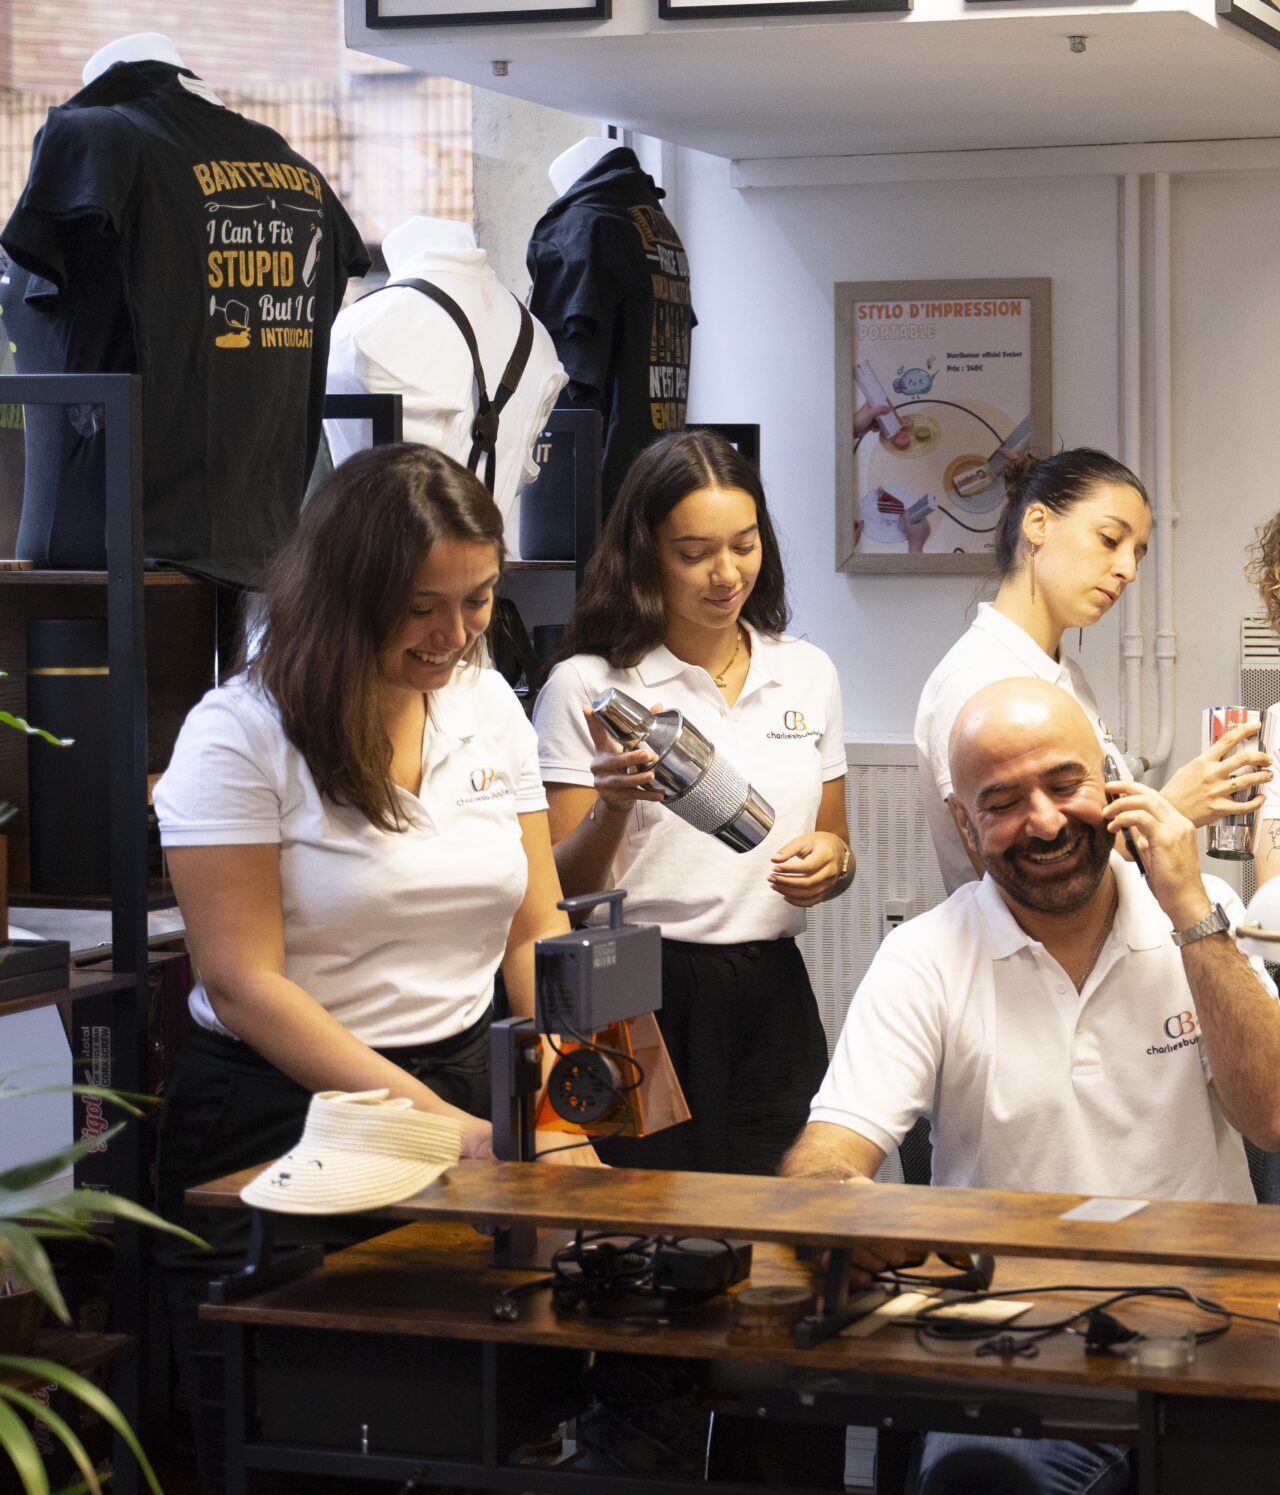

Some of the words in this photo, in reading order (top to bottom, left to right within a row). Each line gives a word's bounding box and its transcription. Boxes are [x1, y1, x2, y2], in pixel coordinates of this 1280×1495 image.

[193, 160, 323, 203] BARTENDER
[206, 219, 216, 244] I
[221, 219, 266, 244] Can't
[268, 220, 294, 245] Fix
[207, 250, 294, 288] STUPID
[259, 294, 292, 322] But
[295, 296, 304, 322] I
[858, 303, 904, 320] STYLO
[909, 300, 1022, 319] D'IMPRESSION
[859, 323, 937, 341] PORTABLE
[101, 1027, 110, 1086] CORKSCREW
